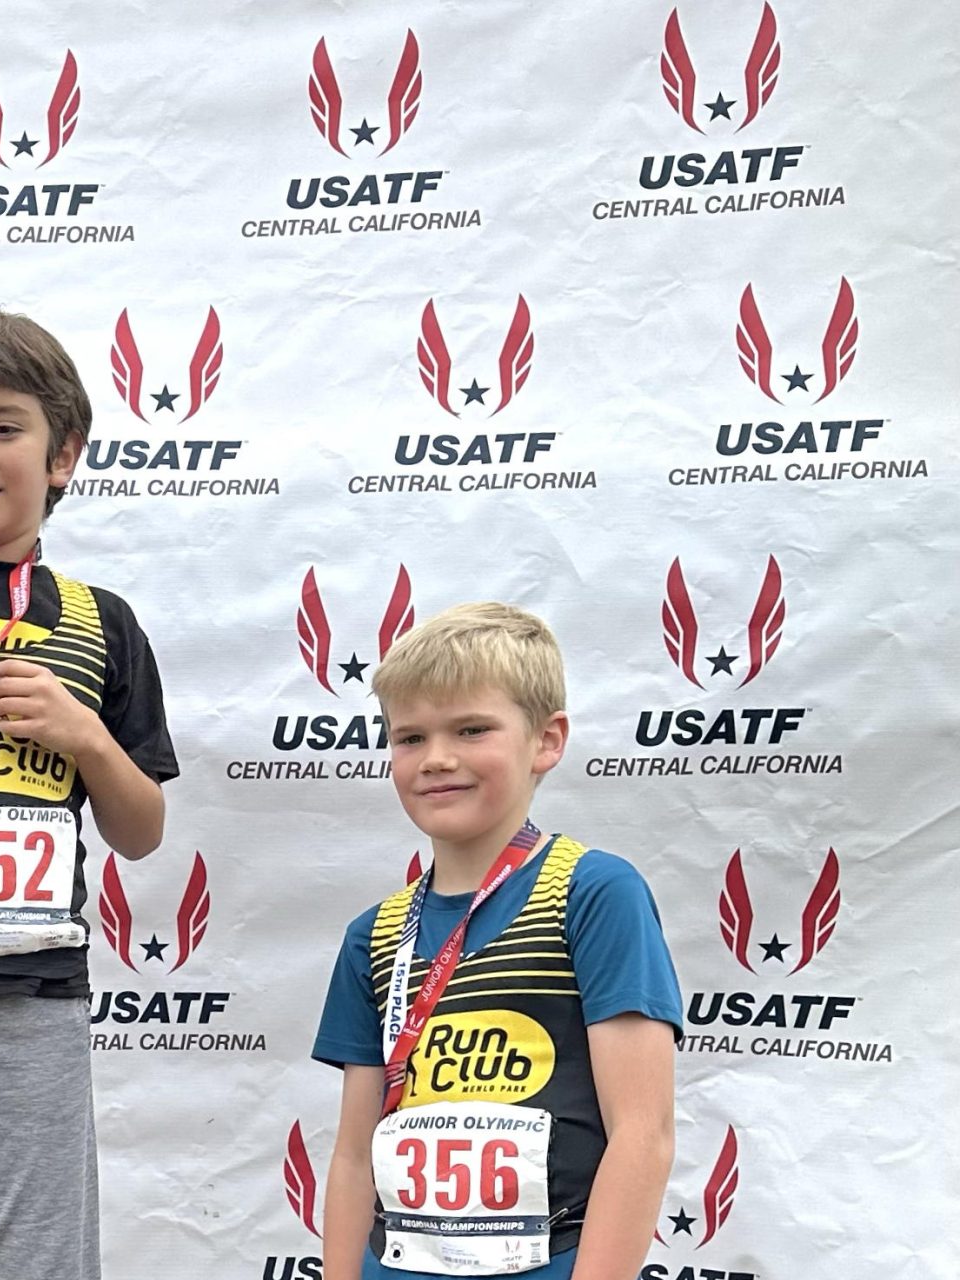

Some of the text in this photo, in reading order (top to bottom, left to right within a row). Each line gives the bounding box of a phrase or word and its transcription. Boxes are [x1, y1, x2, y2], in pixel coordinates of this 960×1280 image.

[639, 146, 804, 189] USATF
[287, 171, 443, 209] USATF
[593, 187, 844, 219] CENTRAL CALIFORNIA
[7, 226, 134, 243] CALIFORNIA
[242, 210, 481, 237] CENTRAL CALIFORNIA
[395, 432, 556, 465] USATF
[716, 420, 884, 456] USATF
[86, 440, 243, 470] USATF
[147, 478, 280, 497] CALIFORNIA
[349, 472, 596, 493] CENTRAL CALIFORNIA
[668, 460, 928, 486] CENTRAL CALIFORNIA
[272, 715, 389, 751] USAT
[636, 709, 805, 746] USATF
[227, 762, 329, 780] CENTRAL
[586, 755, 842, 777] CENTRAL CALIFORNIA
[7, 808, 73, 824] OLYMPIC
[393, 962, 406, 991] 15TH
[422, 965, 445, 1002] JUNIOR
[389, 997, 402, 1042] PLACE
[687, 992, 855, 1030] USATF
[139, 1034, 268, 1051] CALIFORNIA
[427, 1024, 508, 1061] Run
[751, 1037, 892, 1063] CALIFORNIA
[431, 1041, 532, 1093] Club
[461, 1084, 527, 1094] MENLO PARK
[400, 1116, 546, 1133] JUNIOR OLYMPIC
[396, 1138, 520, 1212] 356
[401, 1219, 526, 1232] REGIONAL CHAMPIONSHIPS
